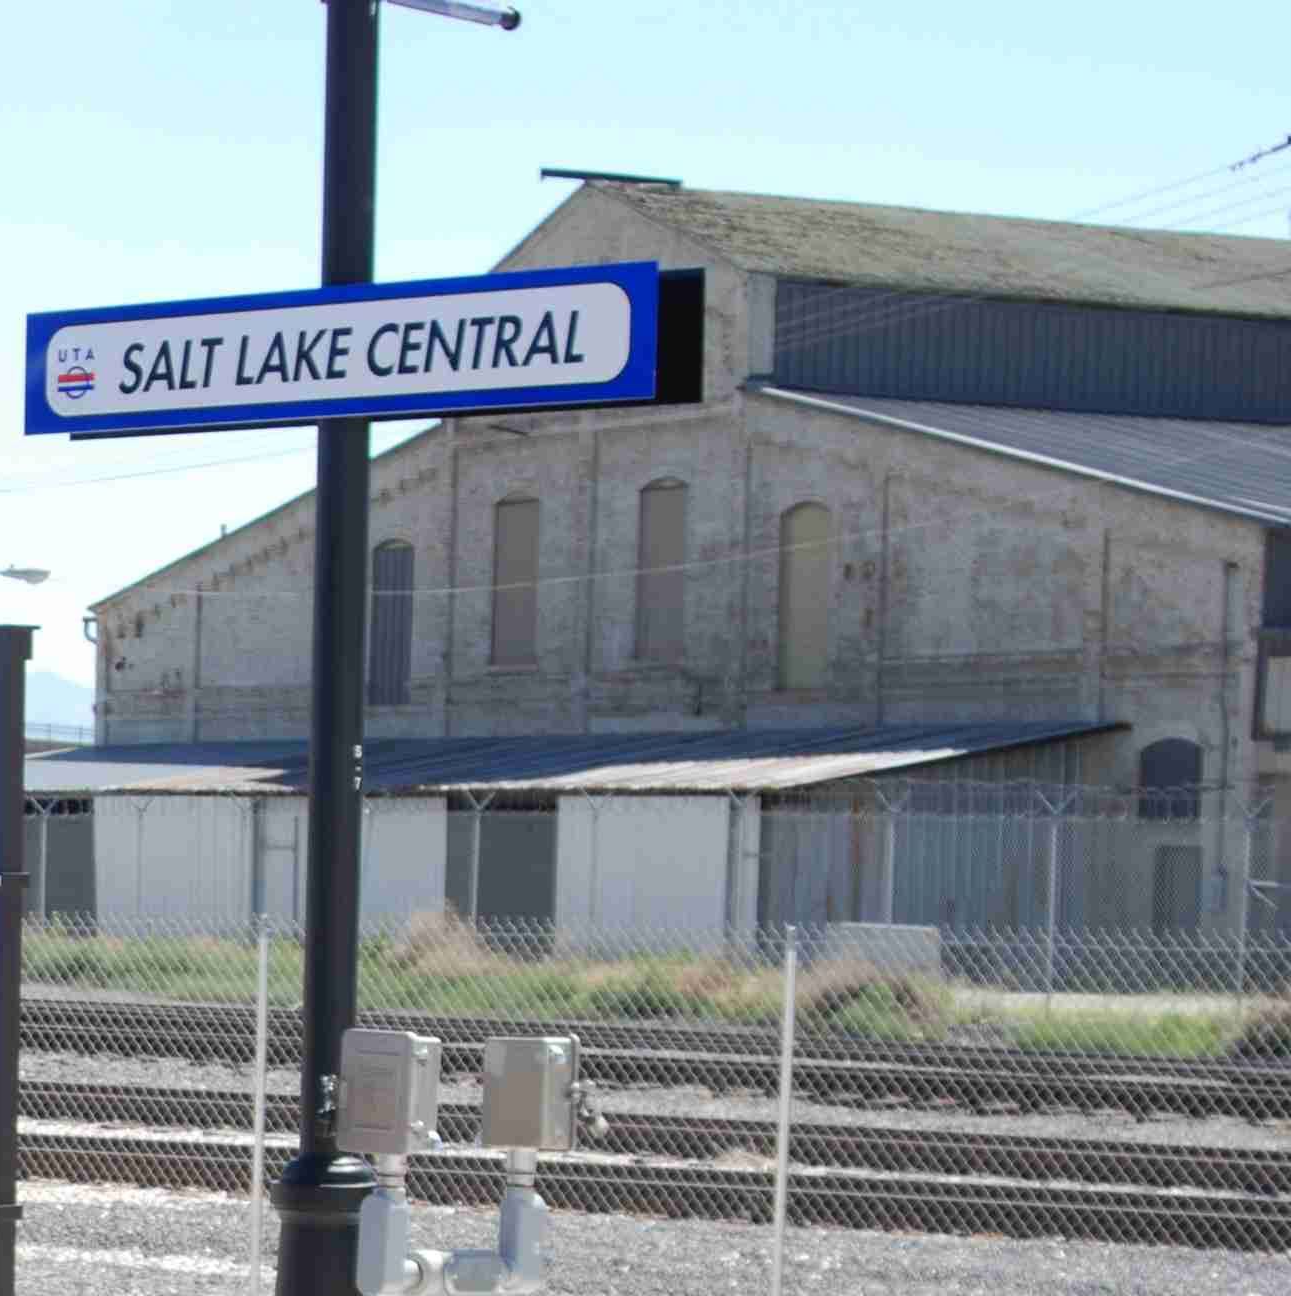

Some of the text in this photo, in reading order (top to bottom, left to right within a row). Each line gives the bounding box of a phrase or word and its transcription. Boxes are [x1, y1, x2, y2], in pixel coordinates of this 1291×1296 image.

[58, 347, 95, 363] UTA
[119, 310, 585, 395] SALT LAKE CENTRAL
